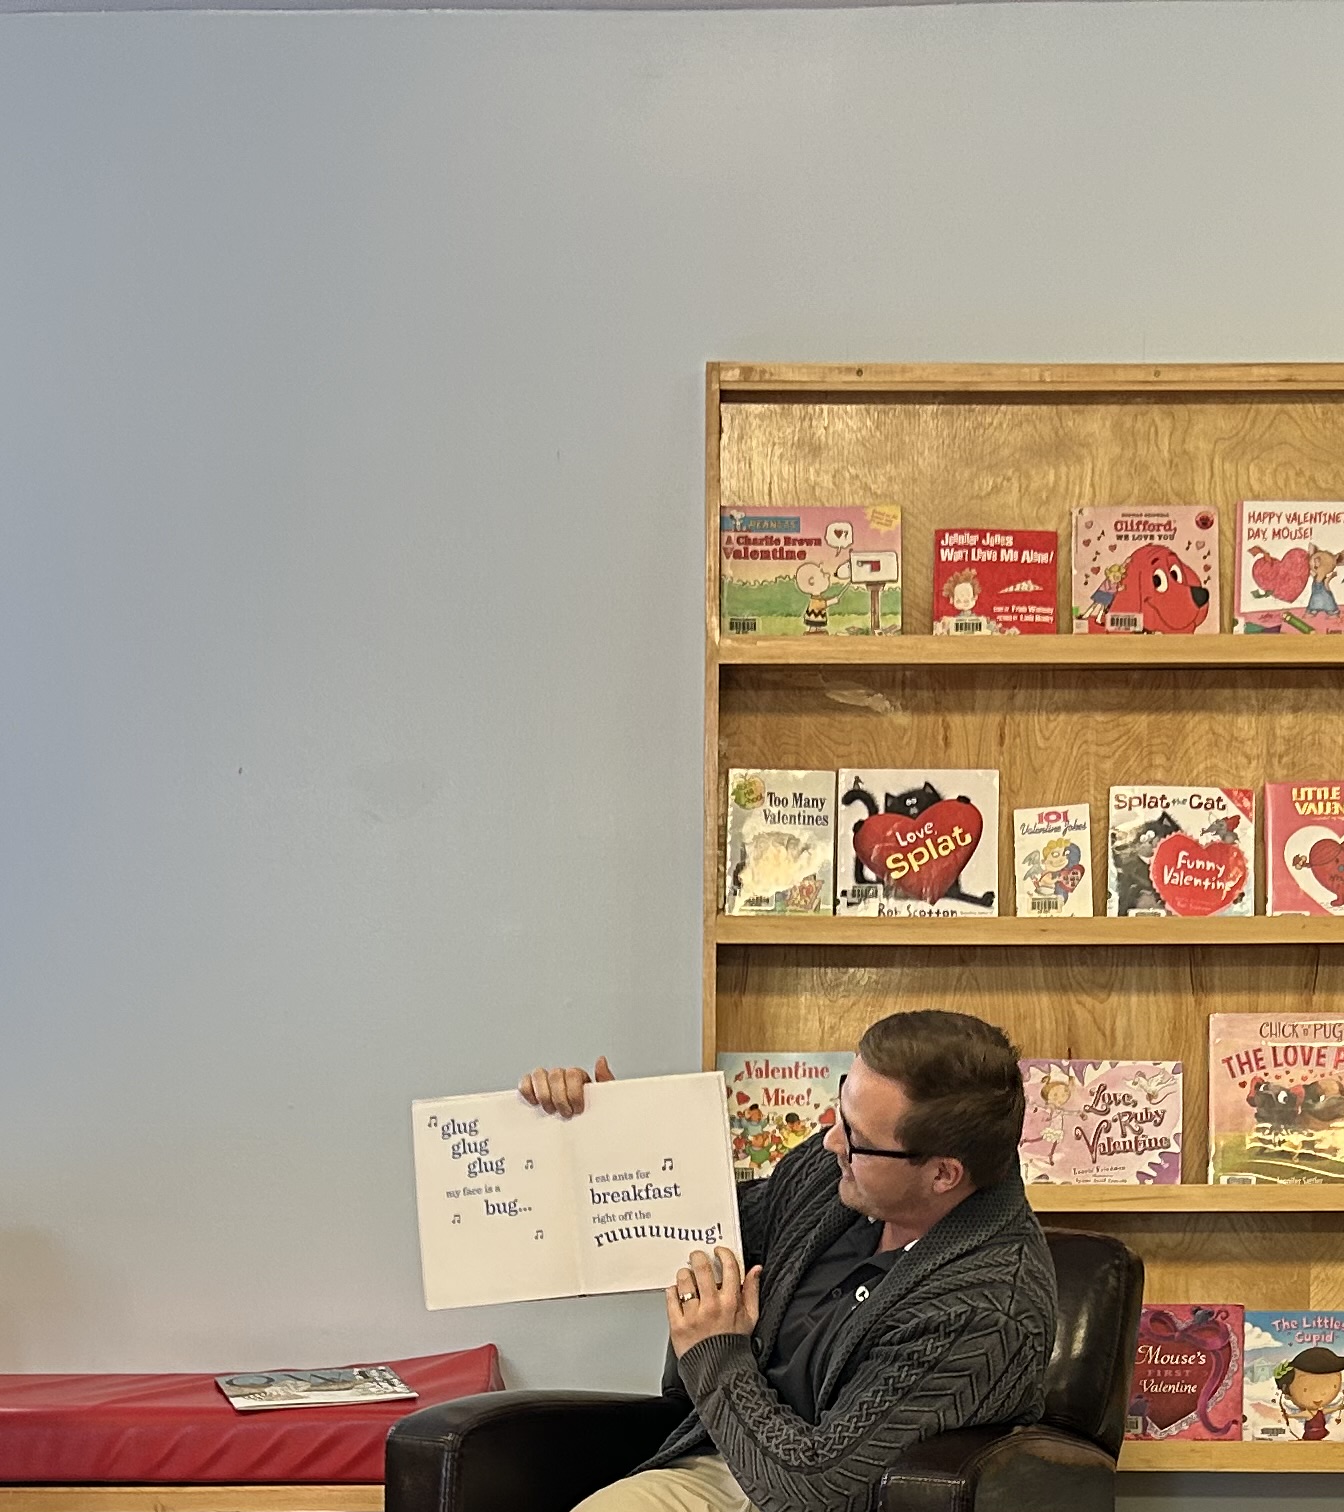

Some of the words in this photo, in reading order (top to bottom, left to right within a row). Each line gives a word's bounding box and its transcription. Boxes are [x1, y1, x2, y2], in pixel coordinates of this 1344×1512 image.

[1113, 519, 1178, 533] Clifford,
[1247, 510, 1283, 524] HAPPY
[736, 534, 781, 547] Charlie
[783, 536, 823, 547] Brown
[1272, 527, 1313, 541] MOUSE!
[722, 547, 807, 561] Valentine
[767, 791, 788, 808] Too
[792, 792, 826, 812] Many
[1114, 793, 1170, 811] Splat
[1189, 794, 1227, 811] Cat
[1292, 786, 1341, 801] LITTLE
[763, 808, 829, 826] Valentines
[1037, 810, 1070, 824] 101
[895, 822, 938, 847] Love,
[885, 825, 973, 880] Splat
[1177, 850, 1226, 878] Funny
[1259, 1022, 1300, 1039] CHICK
[1313, 1023, 1344, 1042] PUG
[744, 1059, 831, 1080] Valentine
[1221, 1047, 1267, 1079] THE
[1271, 1046, 1328, 1068] LOVE
[761, 1086, 813, 1107] Mice!
[1083, 1083, 1138, 1116] Love,
[441, 1118, 479, 1140] glug
[1112, 1107, 1167, 1139] Ruby
[451, 1138, 490, 1160] glug
[1074, 1119, 1171, 1165] Valentine
[467, 1157, 506, 1178] glug
[588, 1174, 593, 1184] I
[594, 1173, 611, 1183] eat
[612, 1172, 634, 1181] ants
[635, 1169, 651, 1180] for
[446, 1189, 461, 1199] my
[463, 1186, 483, 1196] face
[484, 1184, 493, 1193] is
[494, 1185, 501, 1193] a
[589, 1182, 682, 1206] breakfast
[484, 1199, 533, 1217] bug...
[592, 1212, 617, 1225] right
[618, 1210, 634, 1221] off
[635, 1209, 652, 1220] the
[594, 1222, 723, 1248] ruuuuuuug!
[1271, 1317, 1299, 1332] The
[1295, 1331, 1335, 1347] Cupid
[1135, 1344, 1207, 1365] Mouse's
[1147, 1369, 1191, 1377] FIRST
[1139, 1379, 1198, 1394] Valentine
